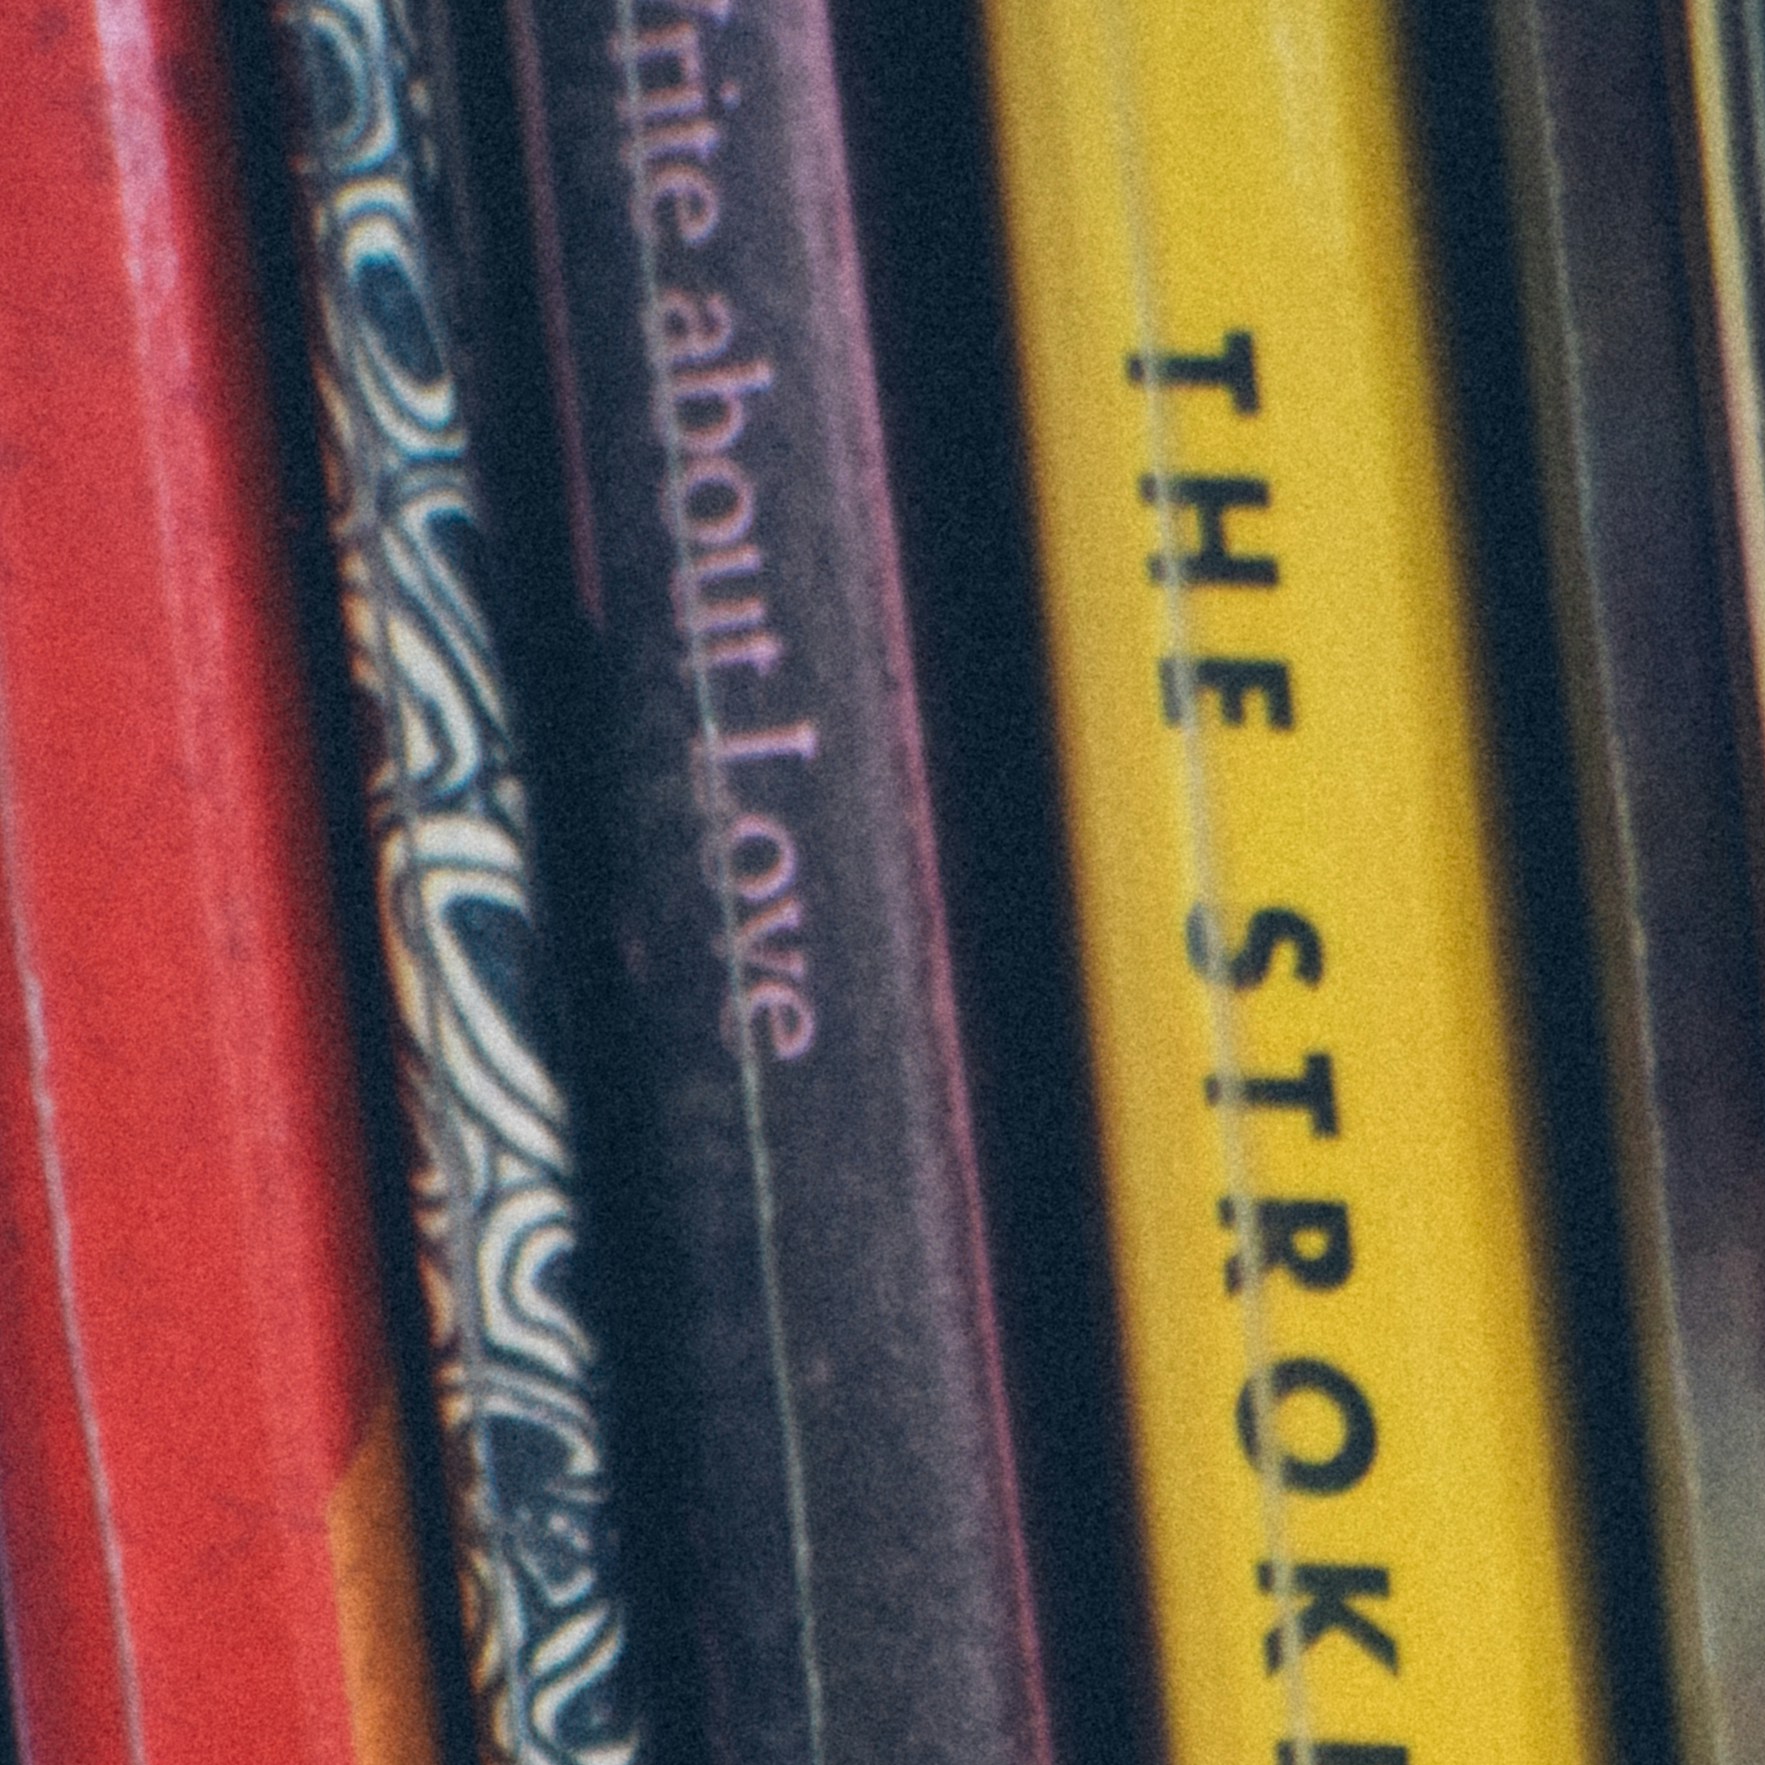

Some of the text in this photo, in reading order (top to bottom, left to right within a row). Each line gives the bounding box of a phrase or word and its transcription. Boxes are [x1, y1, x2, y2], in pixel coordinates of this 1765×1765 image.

[642, 286, 777, 675] about
[1125, 328, 1297, 733] THE
[690, 719, 820, 1063] Love
